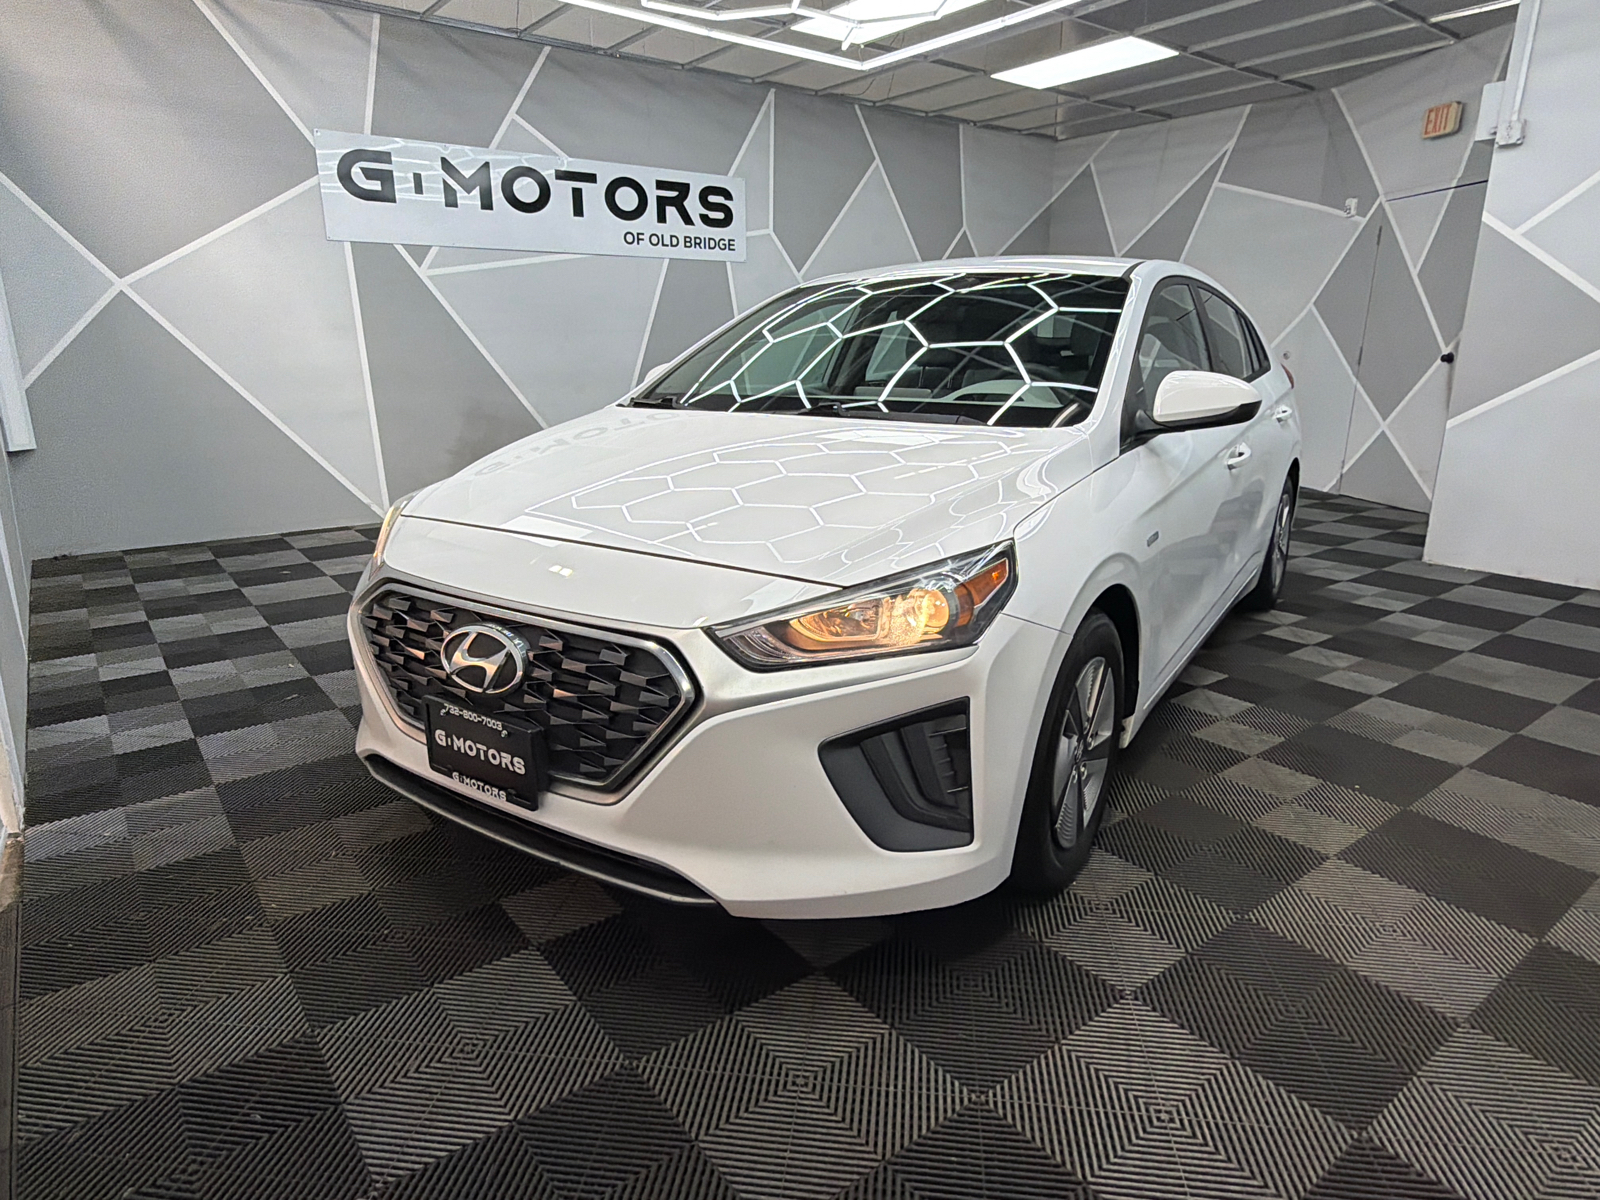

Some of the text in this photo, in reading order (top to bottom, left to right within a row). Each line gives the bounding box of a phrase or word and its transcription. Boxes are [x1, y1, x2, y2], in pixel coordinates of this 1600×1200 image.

[1424, 104, 1452, 135] EXIT
[623, 230, 736, 251] OF OLD BRIDGE
[443, 703, 503, 730] 732-800-7003
